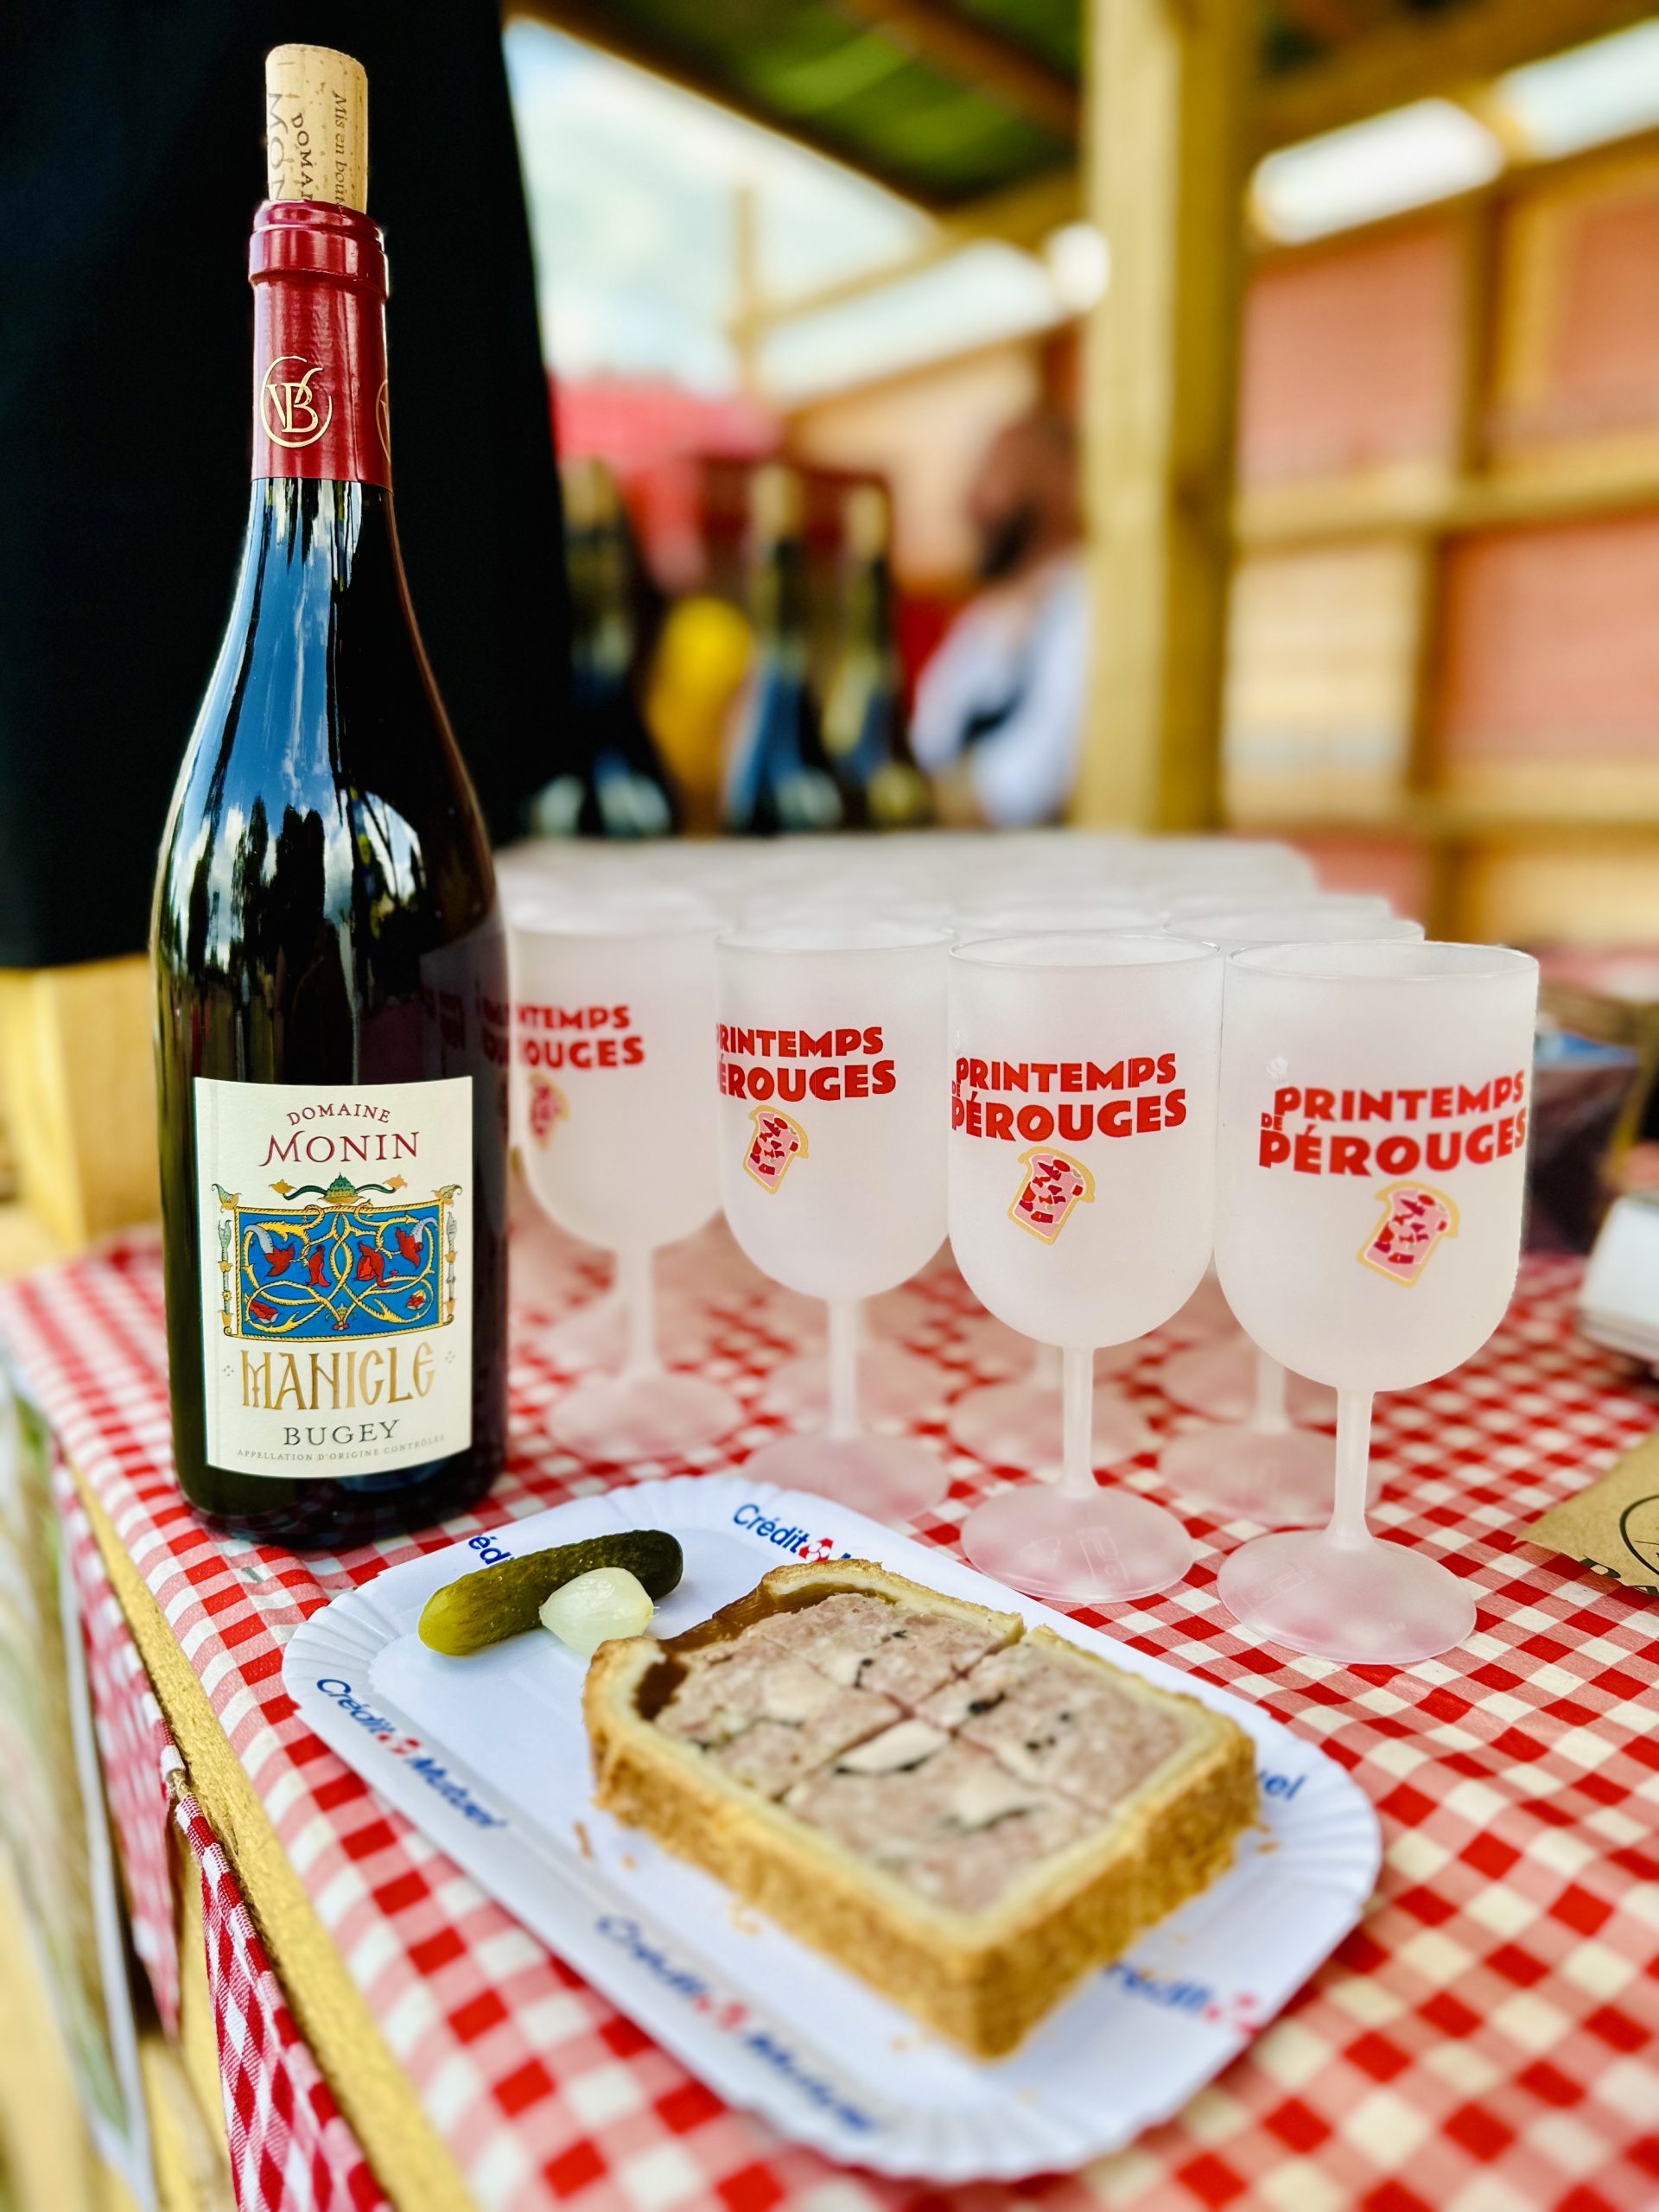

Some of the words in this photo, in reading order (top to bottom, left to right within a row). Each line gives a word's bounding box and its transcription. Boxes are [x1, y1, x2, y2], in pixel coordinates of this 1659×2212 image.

[332, 90, 347, 129] Mis
[334, 132, 346, 156] en
[716, 1022, 884, 1058] RINTEMPS
[951, 1080, 962, 1098] DE
[956, 1052, 1177, 1093] PRINTEMPS
[286, 1103, 391, 1126] DOMAINE
[1273, 1069, 1525, 1122] PRINTEMPS
[951, 1088, 1187, 1142] PÉROUGES
[1260, 1111, 1284, 1132] DE
[258, 1130, 420, 1167] MONIN
[1258, 1106, 1527, 1178] PÉROUGES
[240, 1341, 436, 1411] MANICLE
[283, 1419, 400, 1446] BUGEY
[238, 1448, 314, 1462] APPELLATION
[317, 1448, 379, 1461] D'ORIGINE
[733, 1503, 810, 1554] Crédit
[316, 1678, 396, 1734] Crédit
